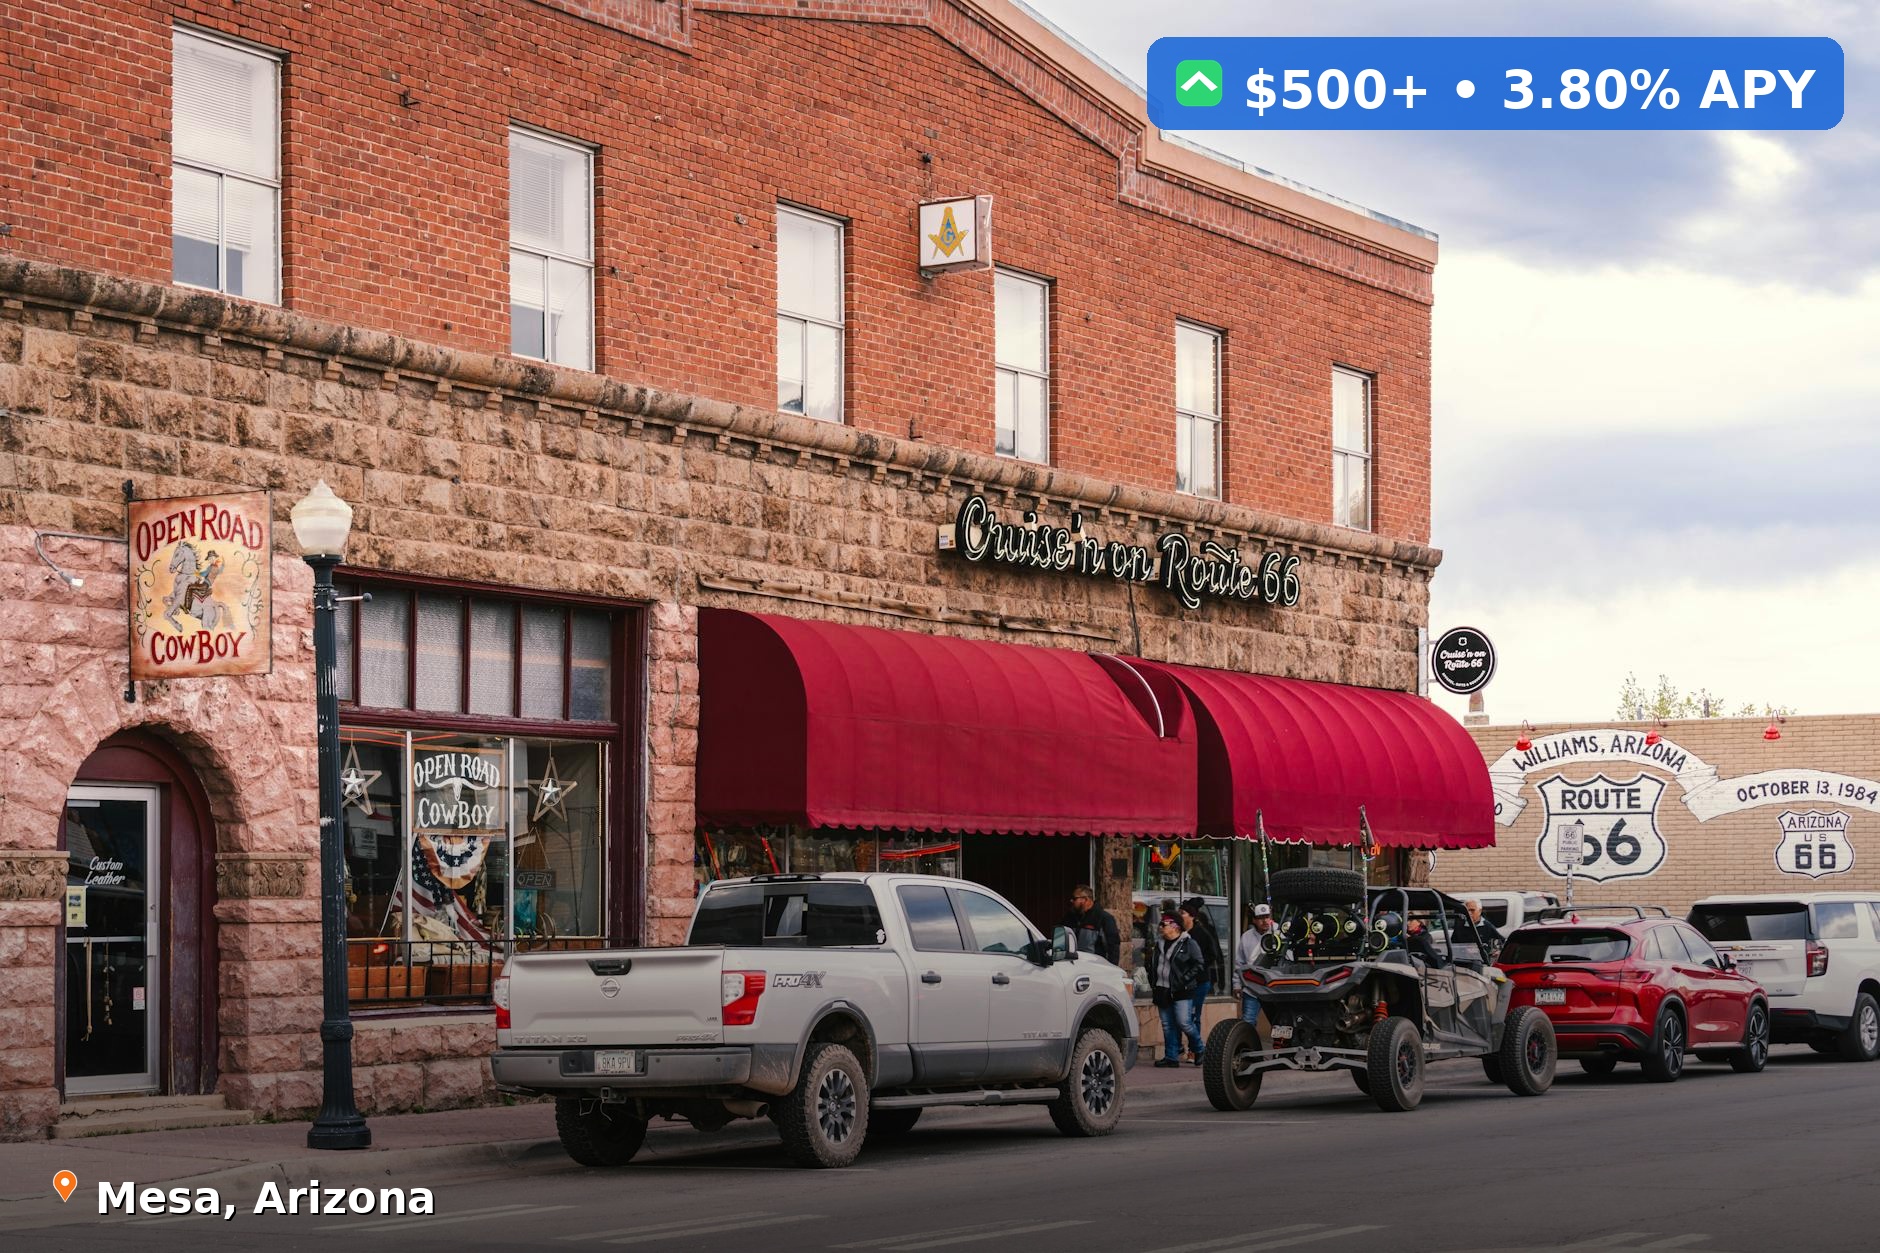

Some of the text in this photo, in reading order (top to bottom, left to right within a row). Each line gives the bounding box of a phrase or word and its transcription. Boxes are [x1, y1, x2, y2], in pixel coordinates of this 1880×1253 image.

[137, 503, 263, 562] OPEN ROAD
[955, 496, 1301, 609] Cruise'n on Route 66
[1444, 659, 1483, 671] Route 66
[1512, 735, 1688, 773] WILLIAMS, ARIZONA
[413, 753, 500, 788] OPEN ROAD
[1561, 788, 1642, 810] ROUTE
[1737, 780, 1809, 802] OCTOBER
[1838, 782, 1878, 805] 1984
[1787, 816, 1842, 829] ARIZONA
[89, 856, 123, 871] Custom
[84, 871, 126, 885] Leather
